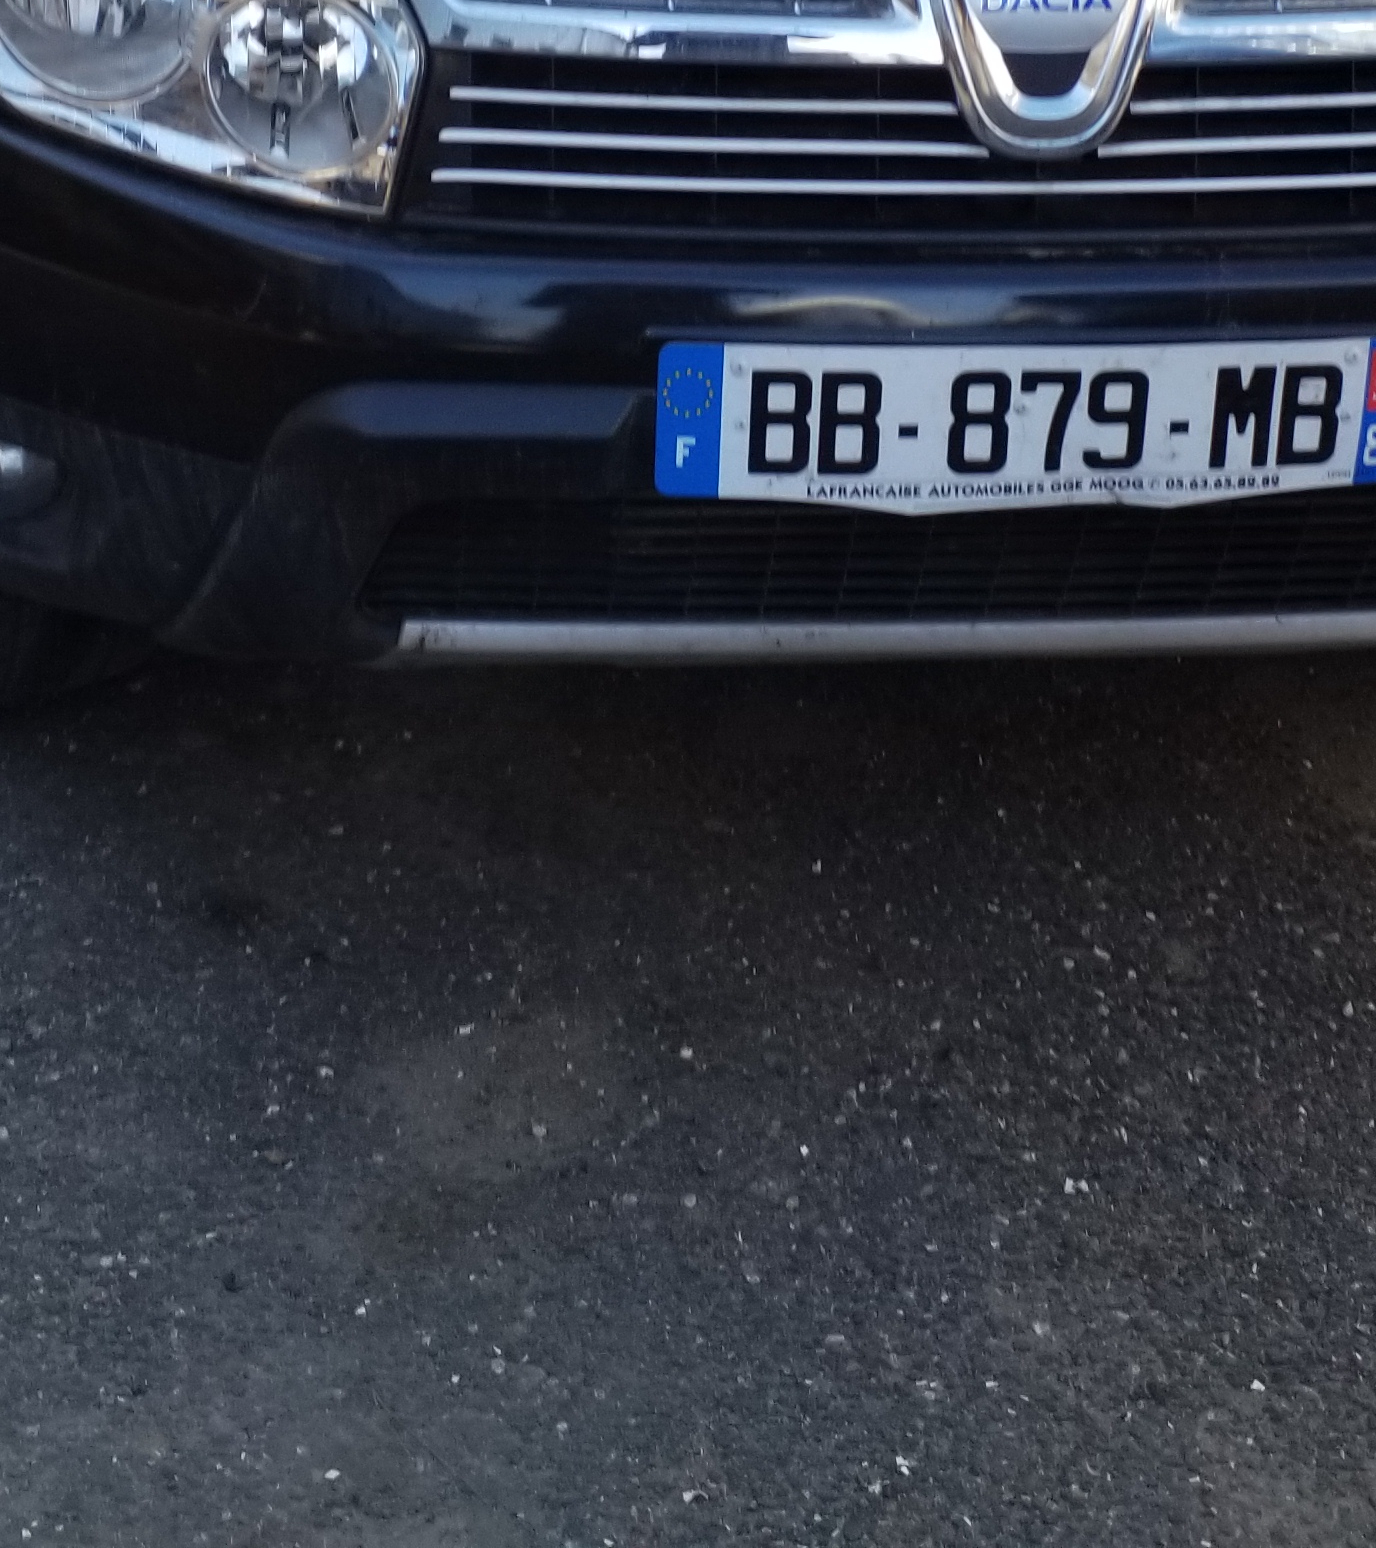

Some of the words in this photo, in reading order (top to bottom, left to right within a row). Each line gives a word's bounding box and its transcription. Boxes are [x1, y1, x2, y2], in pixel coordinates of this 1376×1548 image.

[748, 365, 1343, 475] BB-879-MB
[676, 435, 696, 468] F
[928, 480, 1045, 499] AUTOMOBILES
